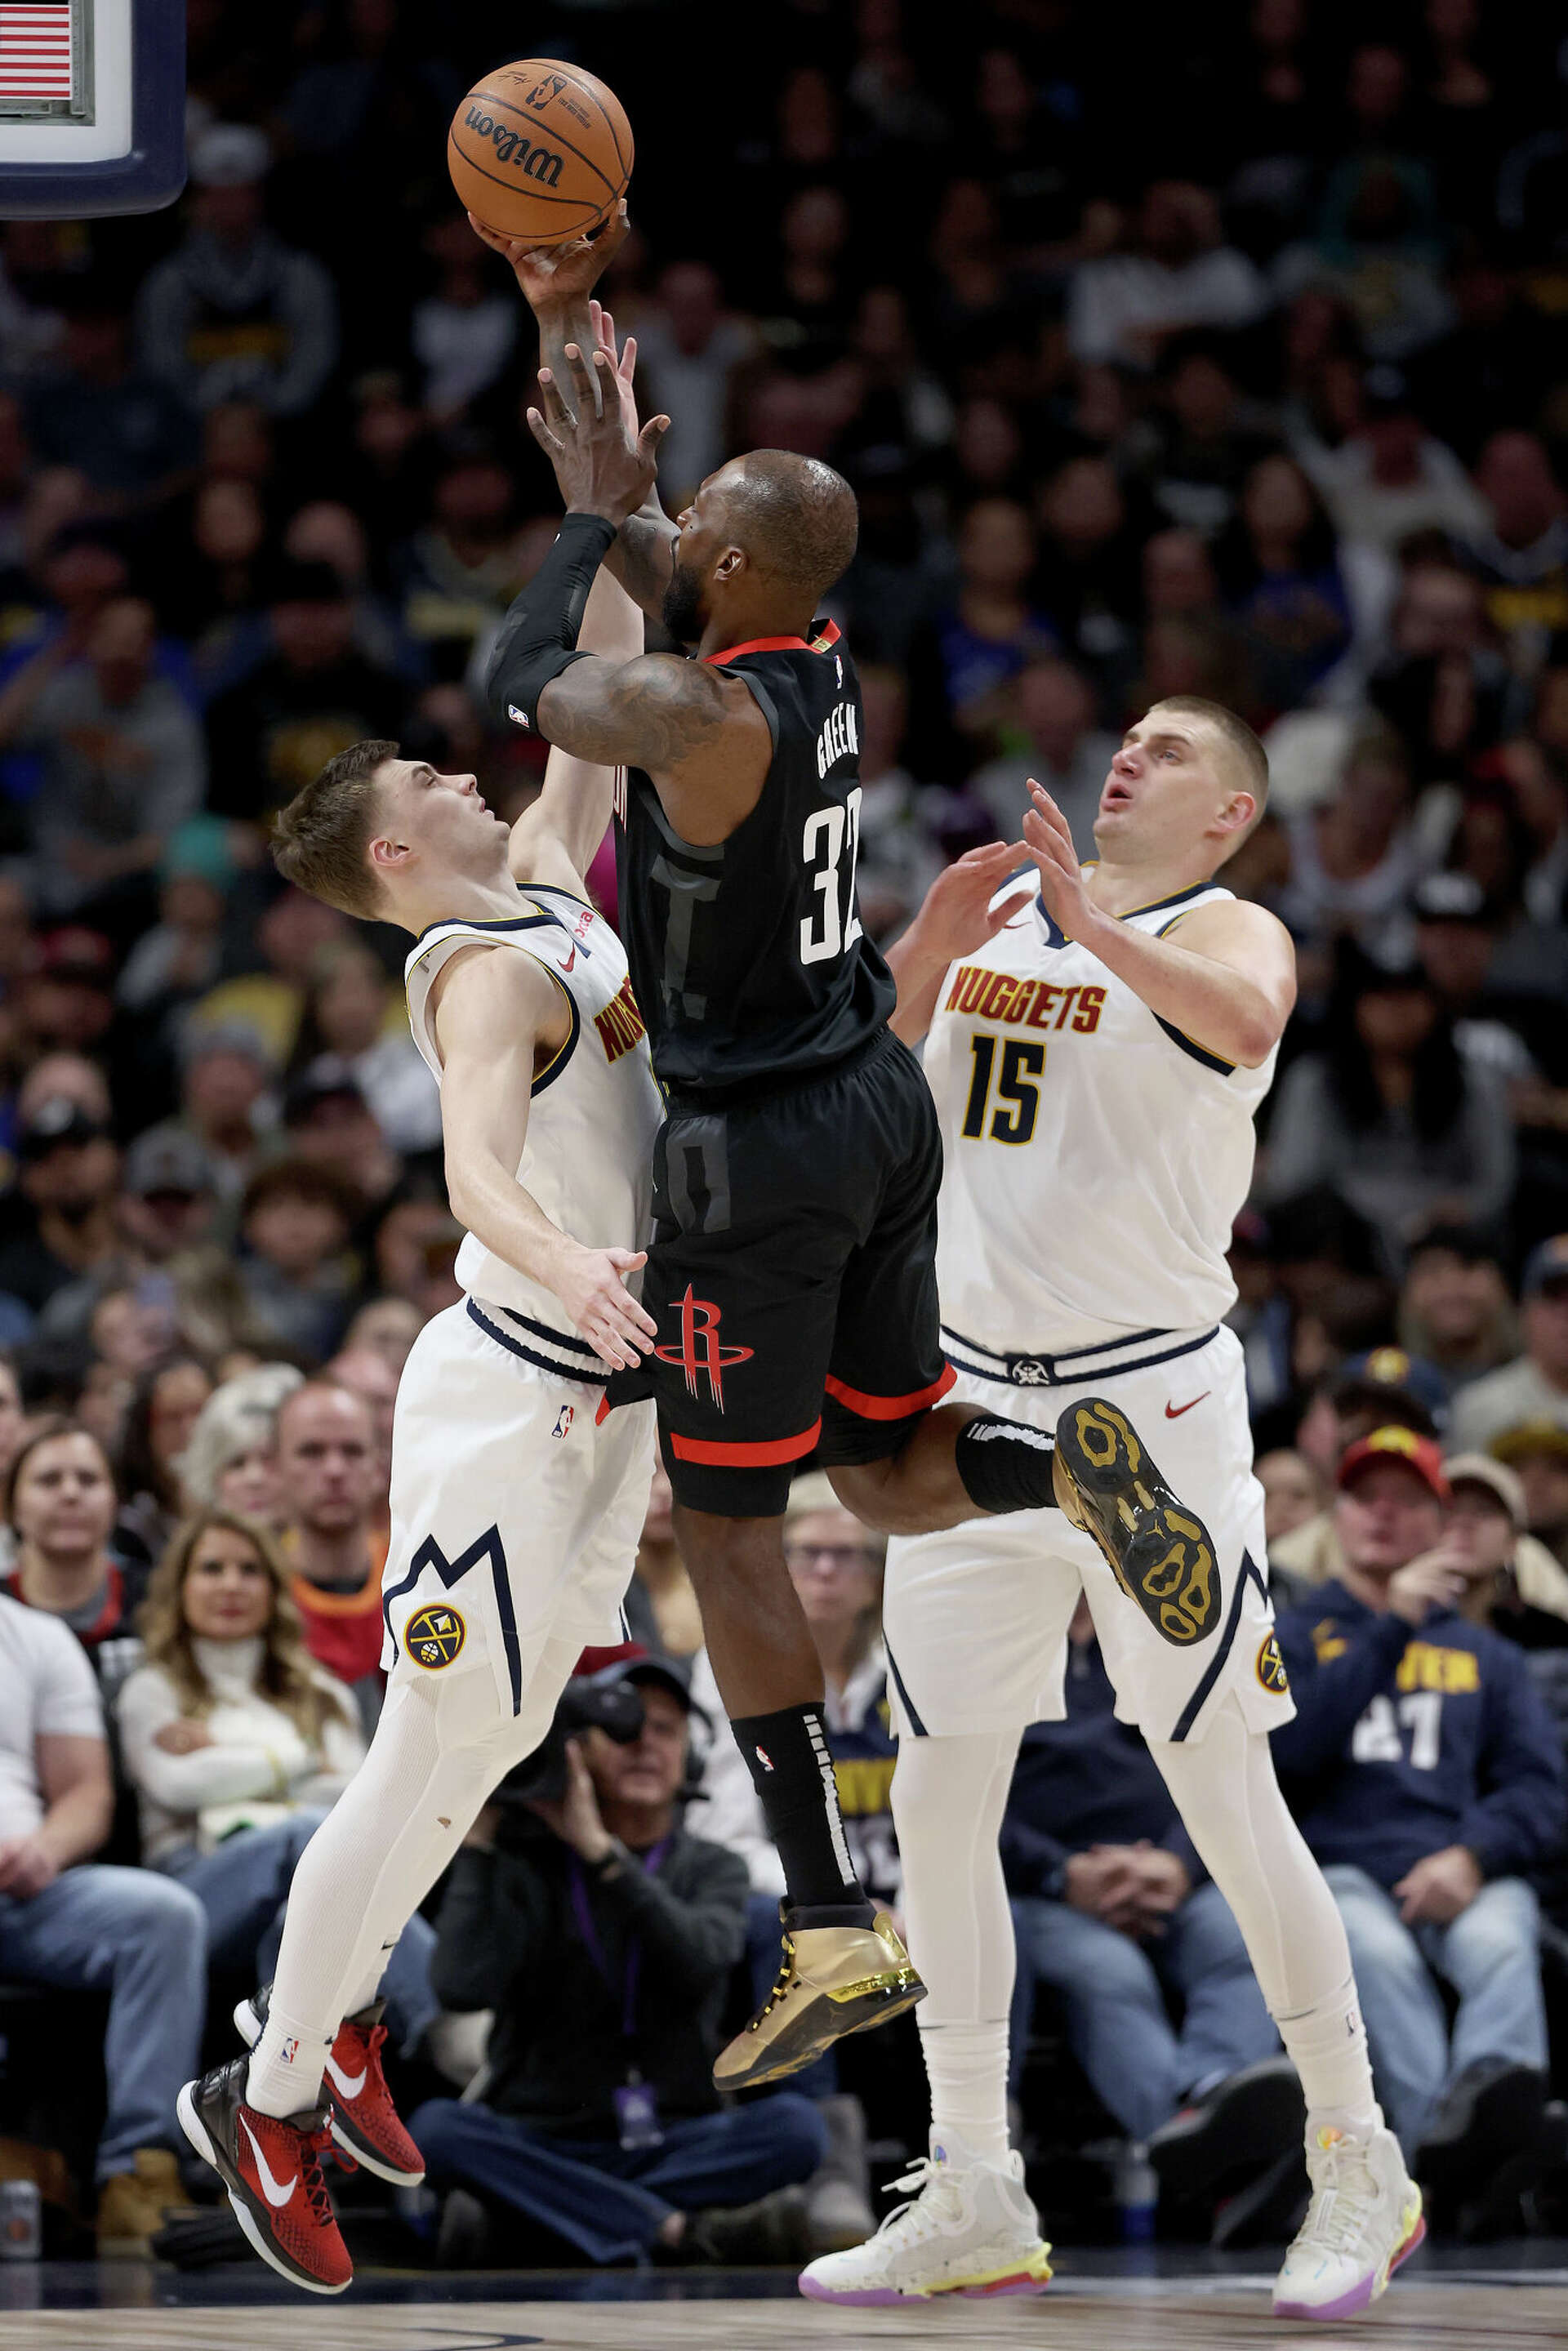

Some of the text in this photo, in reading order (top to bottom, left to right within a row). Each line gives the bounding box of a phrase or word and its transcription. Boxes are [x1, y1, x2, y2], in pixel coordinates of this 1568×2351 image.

[464, 103, 564, 189] Wilson
[817, 701, 858, 780] GREEN
[800, 786, 863, 965] 32
[945, 966, 1107, 1034] NUGGETS
[960, 1031, 1046, 1147] 15
